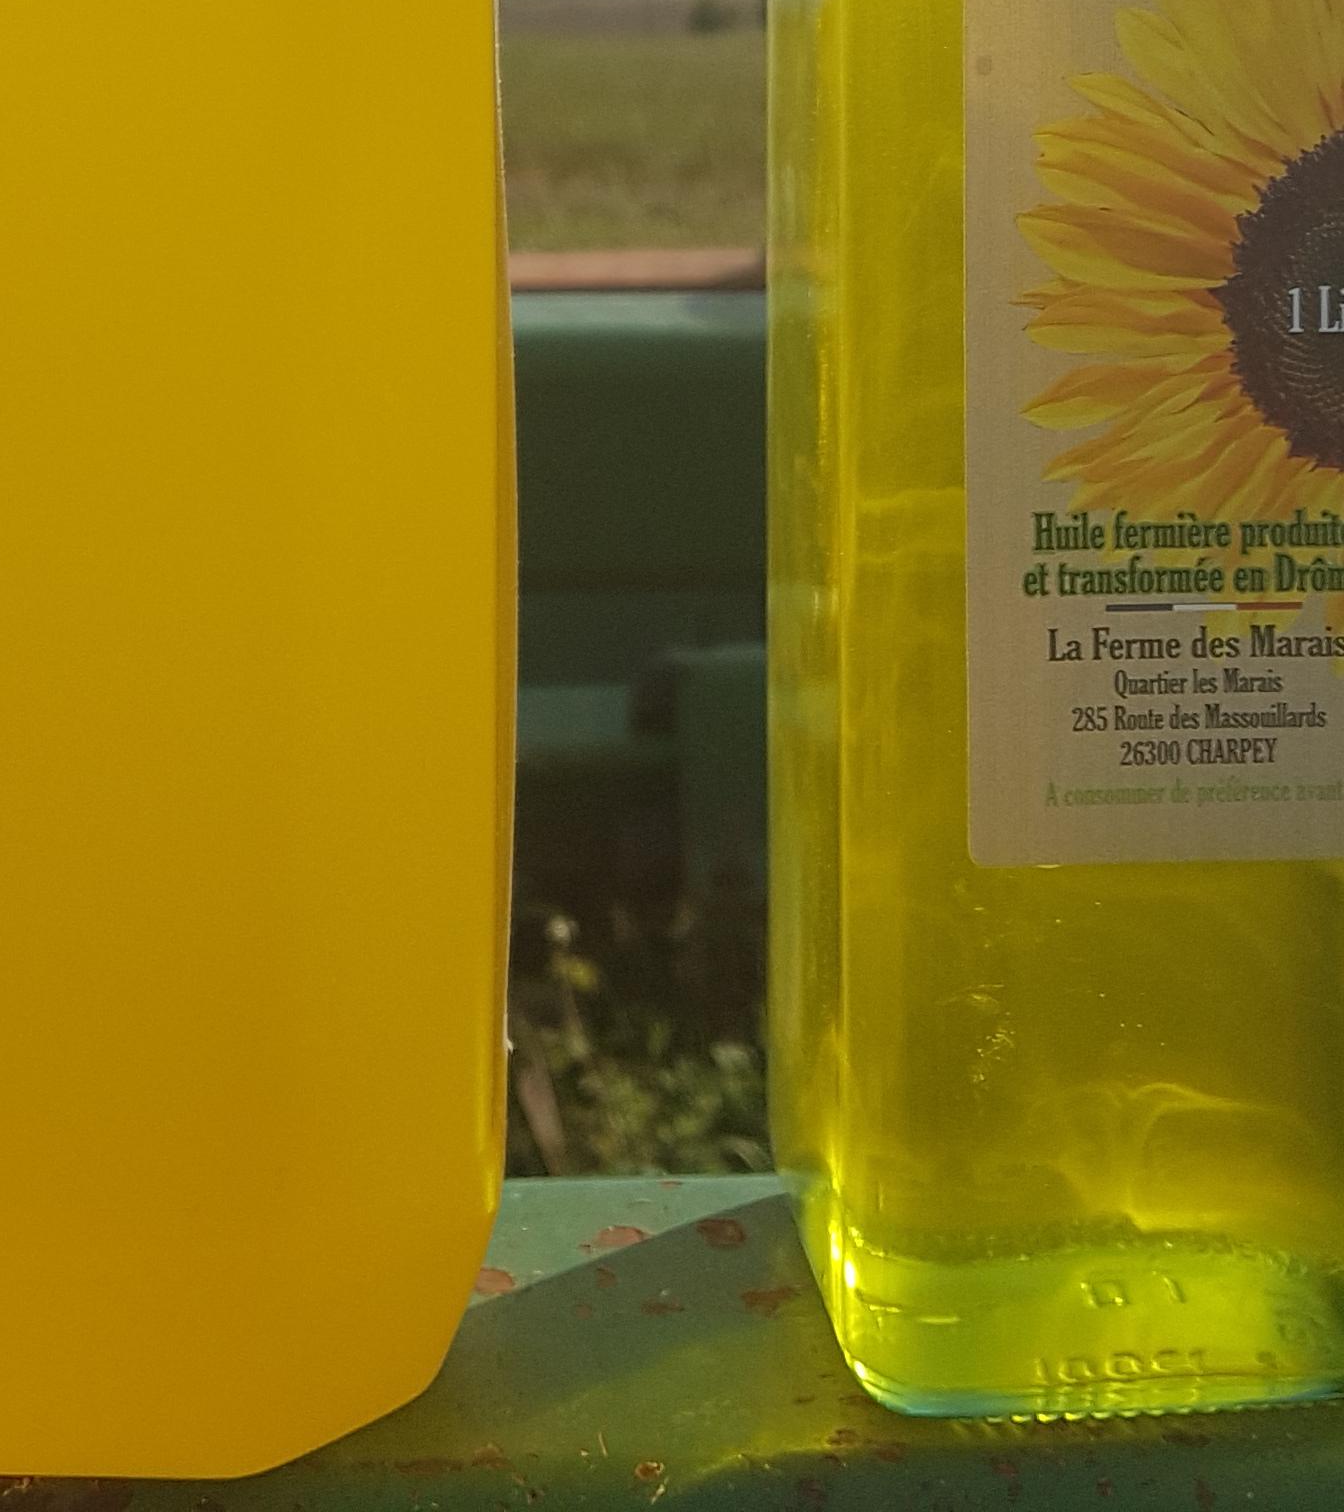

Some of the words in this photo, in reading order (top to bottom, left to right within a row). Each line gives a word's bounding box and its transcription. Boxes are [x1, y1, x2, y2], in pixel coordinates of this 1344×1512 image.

[1287, 287, 1306, 334] 1
[1032, 512, 1105, 552] Huile
[1113, 512, 1231, 550] fermière
[1023, 562, 1049, 597] et
[1057, 557, 1224, 596] transformée
[1232, 565, 1265, 593] en
[1047, 628, 1083, 663] La
[1091, 627, 1181, 661] Ferme
[1191, 625, 1241, 659] des
[1114, 670, 1188, 699] Quartier
[1192, 668, 1219, 695] les
[1222, 668, 1284, 693] Marais
[1072, 707, 1108, 732] 285
[1114, 705, 1165, 731] Route
[1169, 704, 1200, 730] des
[1204, 702, 1327, 730] Massouillards
[1120, 741, 1181, 766] 26300
[1186, 738, 1278, 764] CHARPEY
